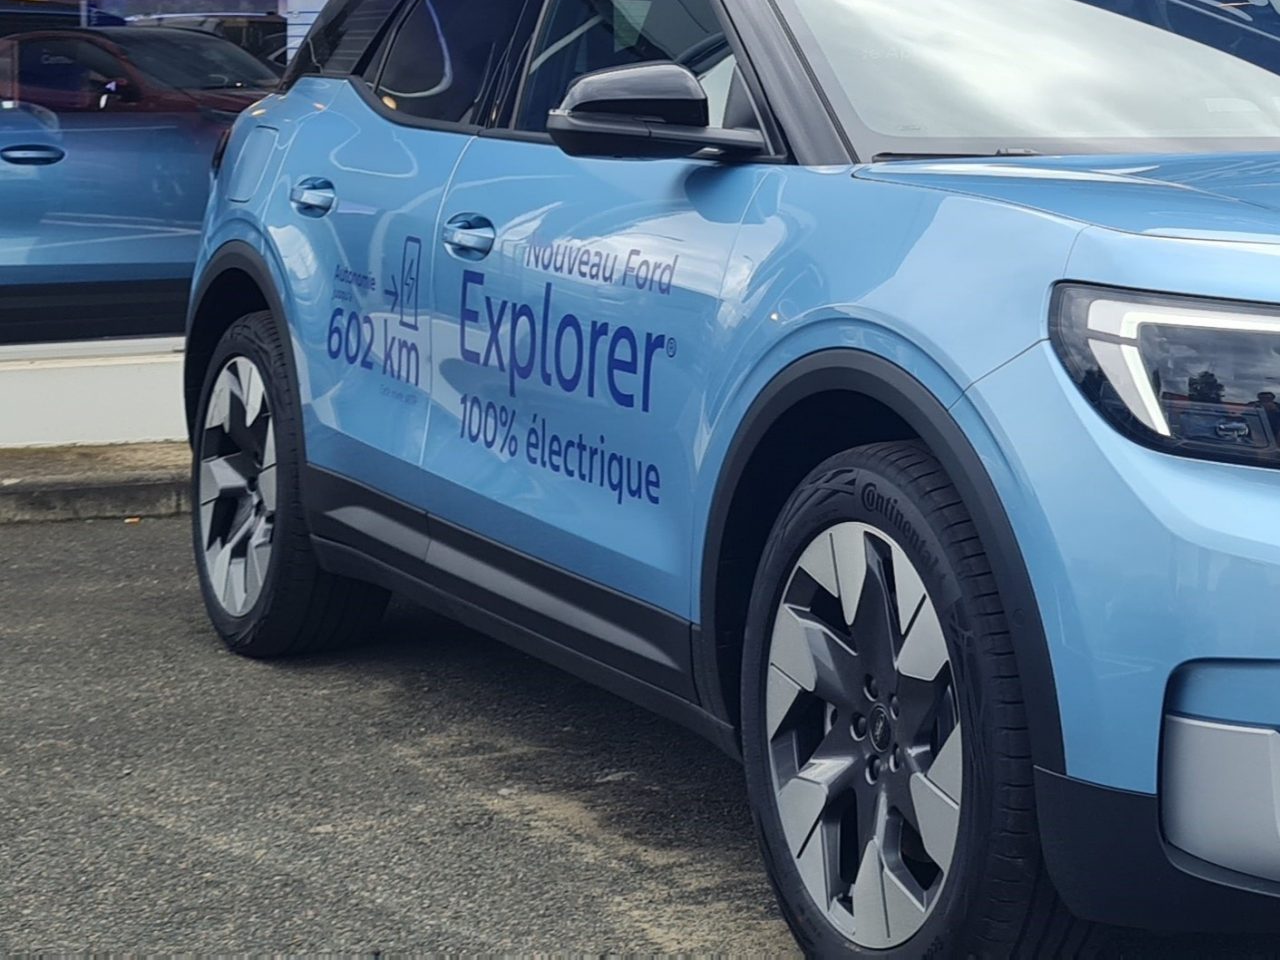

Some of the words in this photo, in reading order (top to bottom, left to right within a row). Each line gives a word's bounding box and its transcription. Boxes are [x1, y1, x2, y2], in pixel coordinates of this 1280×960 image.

[526, 241, 617, 284] Nouveau
[622, 248, 680, 296] Ford
[327, 306, 375, 371] 602
[382, 319, 419, 388] km
[460, 393, 518, 458] 100%
[525, 413, 661, 505] électrique
[861, 481, 940, 571] Continental
